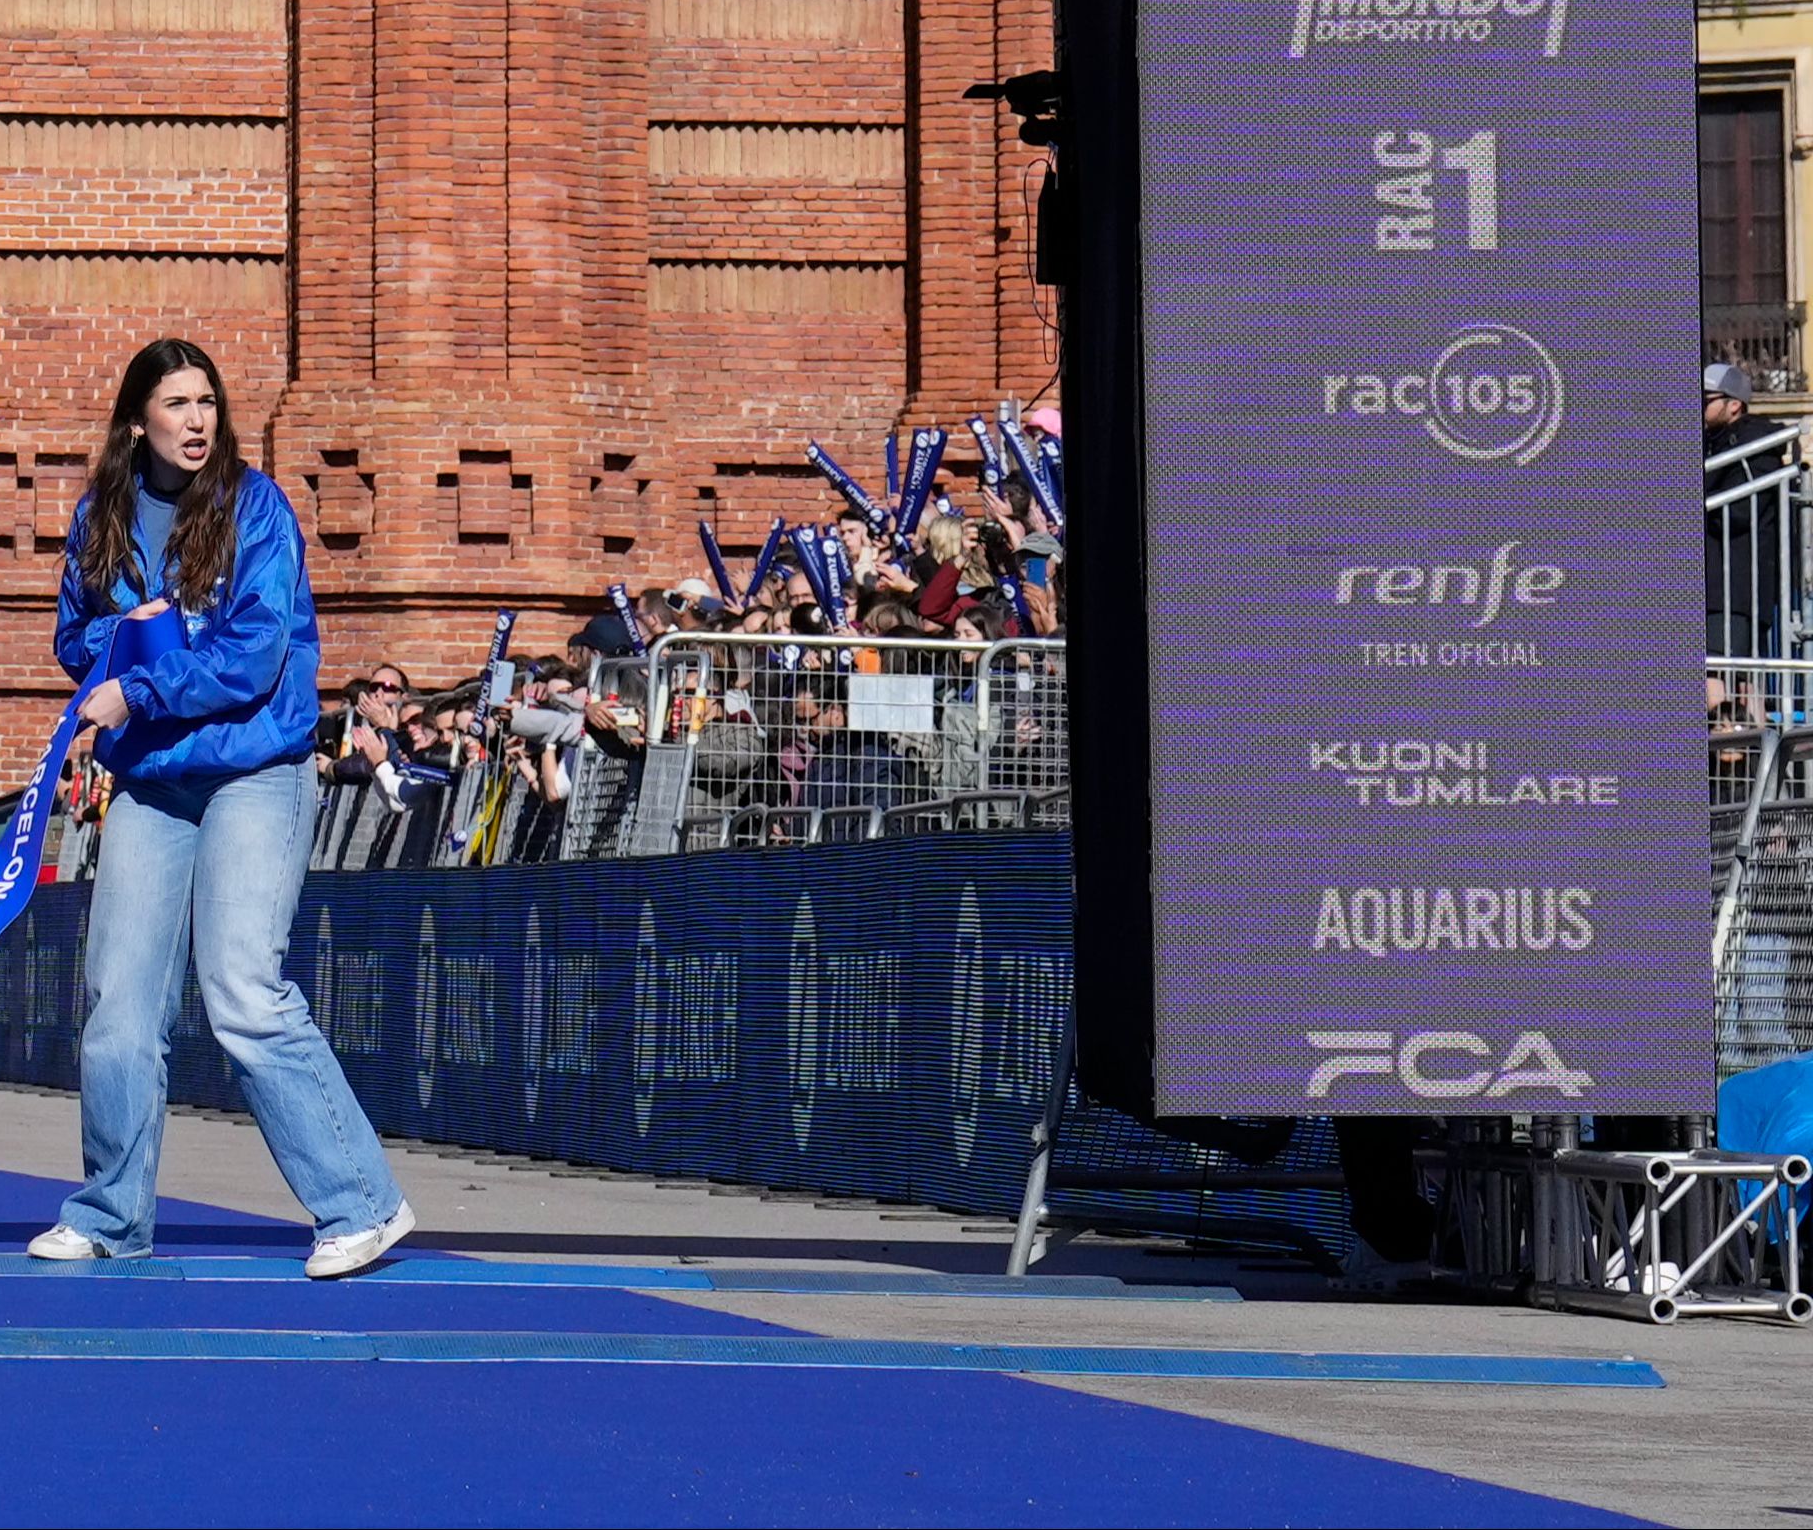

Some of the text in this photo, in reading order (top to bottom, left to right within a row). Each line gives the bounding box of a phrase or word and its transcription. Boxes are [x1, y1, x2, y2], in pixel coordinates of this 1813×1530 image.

[1315, 19, 1492, 42] DEPORTIVO
[1374, 130, 1499, 251] RAC 1
[1333, 541, 1567, 628] renfe
[1360, 642, 1542, 667] TREN OFICIAL
[1310, 742, 1488, 771] KUONI
[1345, 776, 1620, 806] TUMLARE
[1313, 887, 1595, 958] AQUARIUS
[1306, 1031, 1595, 1098] FCA
